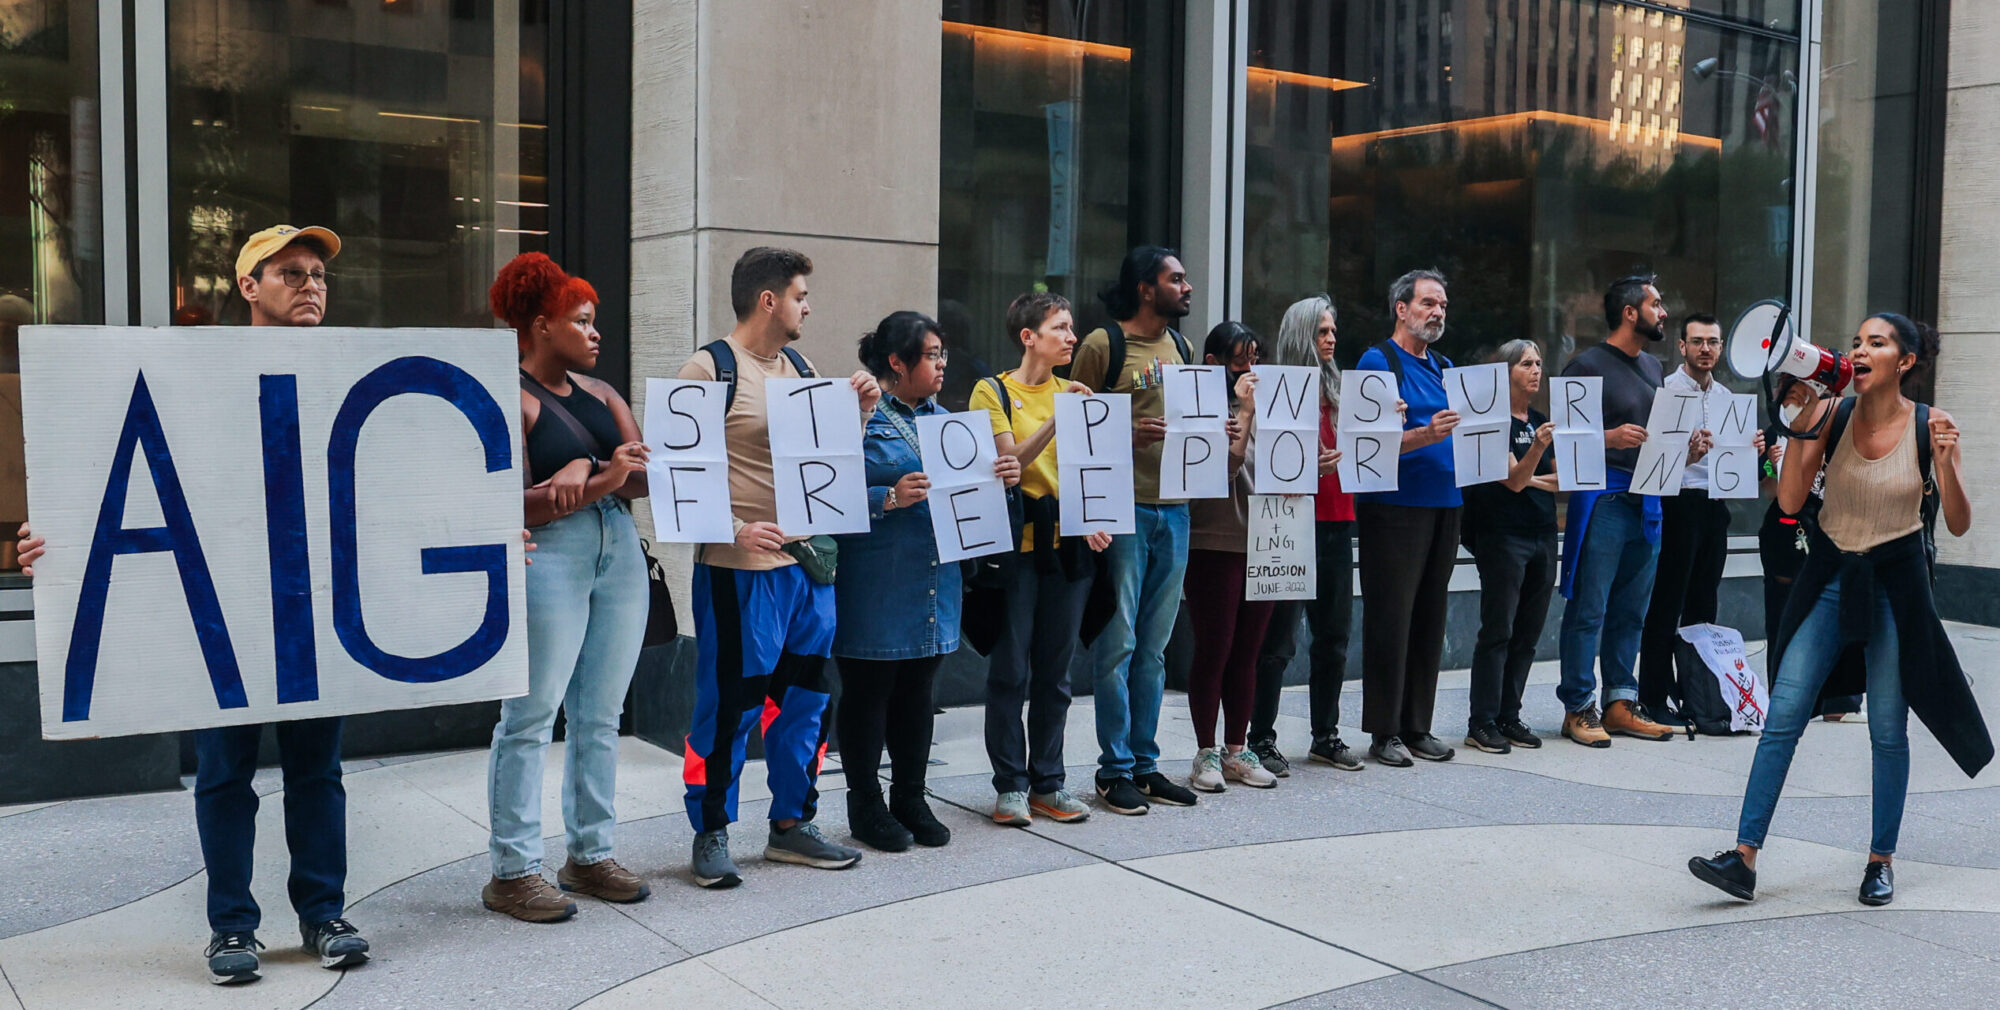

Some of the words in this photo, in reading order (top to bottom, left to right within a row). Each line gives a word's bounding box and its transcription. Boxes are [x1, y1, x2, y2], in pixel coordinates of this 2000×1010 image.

[1261, 497, 1295, 519] AIG
[62, 355, 512, 723] AIG
[1256, 534, 1295, 552] LNG
[1248, 564, 1306, 578] EXPLOSION
[1254, 582, 1282, 595] JUNE
[1285, 582, 1307, 593] 2022
